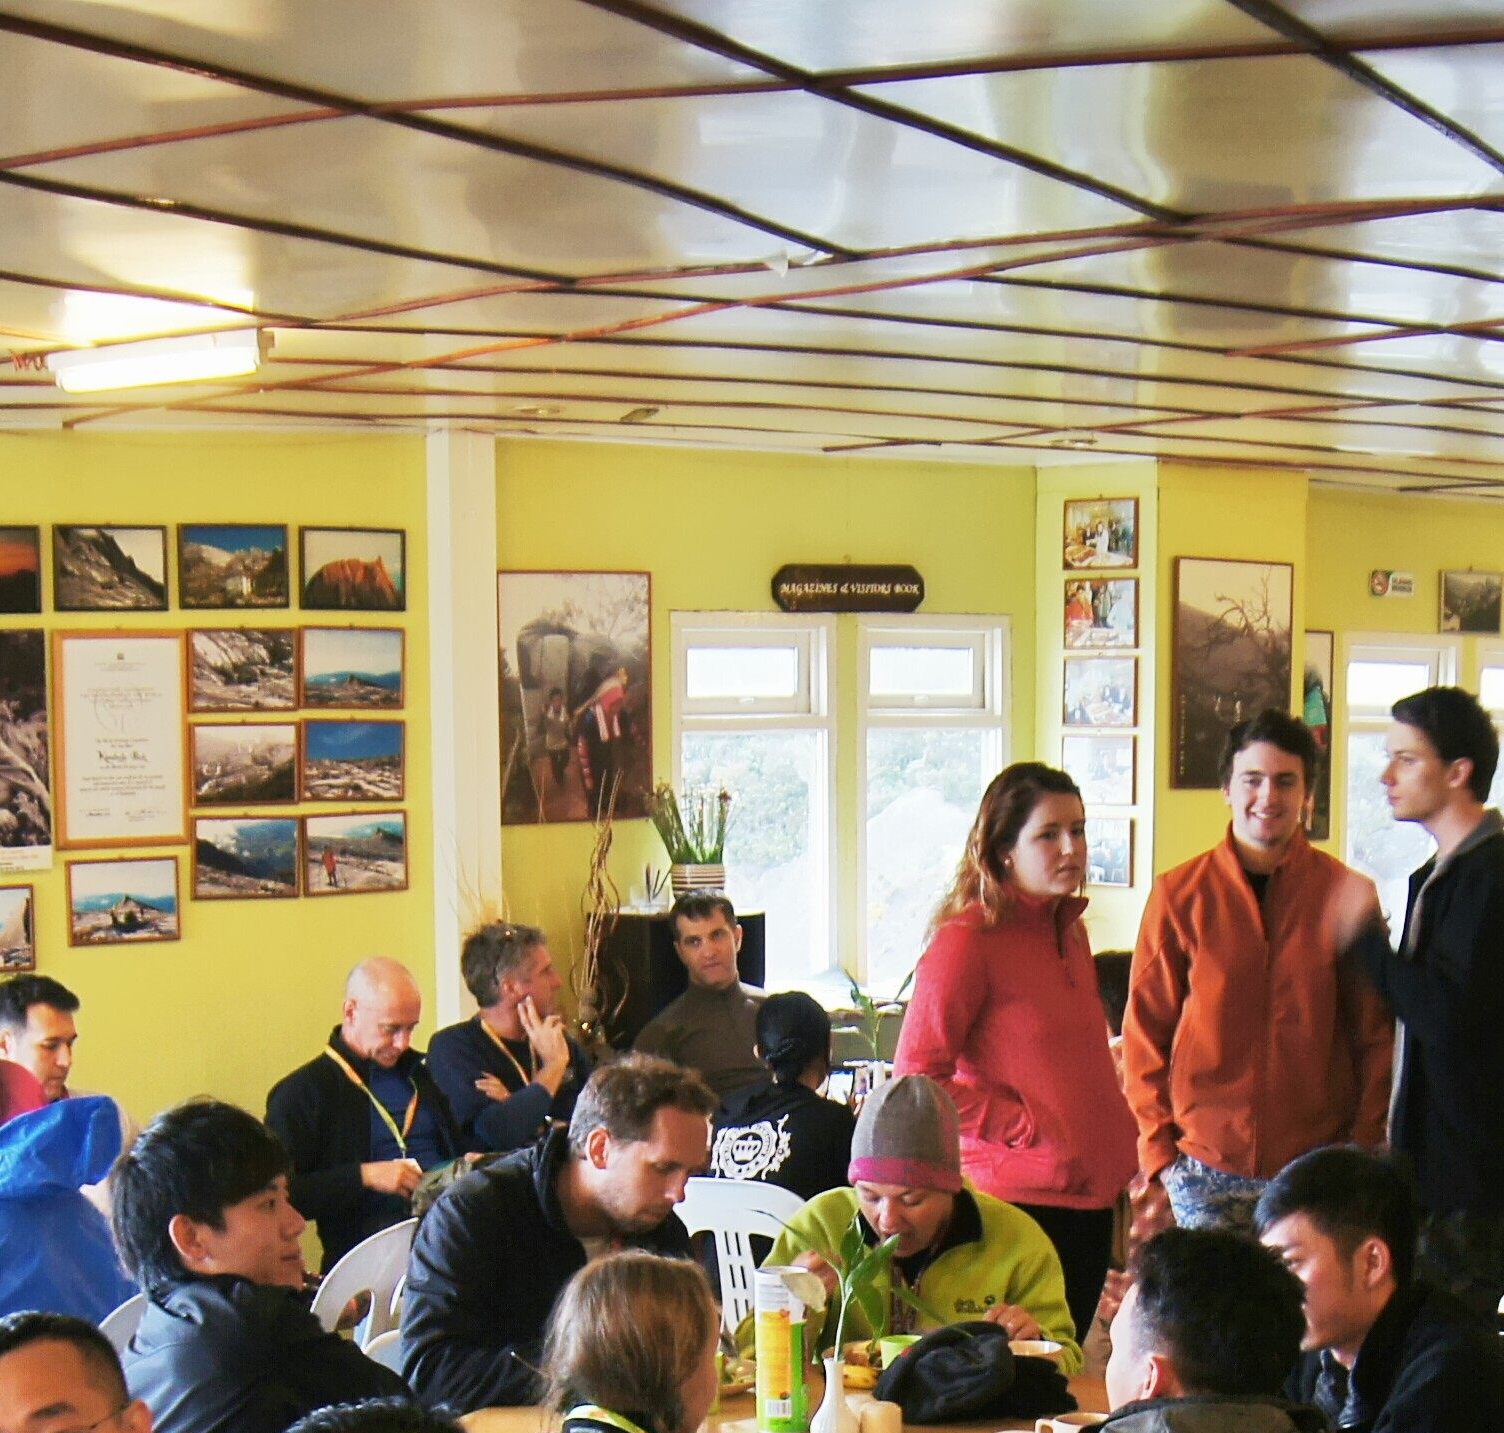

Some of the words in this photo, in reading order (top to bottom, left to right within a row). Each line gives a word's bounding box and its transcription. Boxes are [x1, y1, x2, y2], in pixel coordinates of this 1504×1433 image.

[780, 582, 838, 596] MAGAZINES
[850, 583, 891, 594] VISITORS
[894, 583, 920, 595] BOOK
